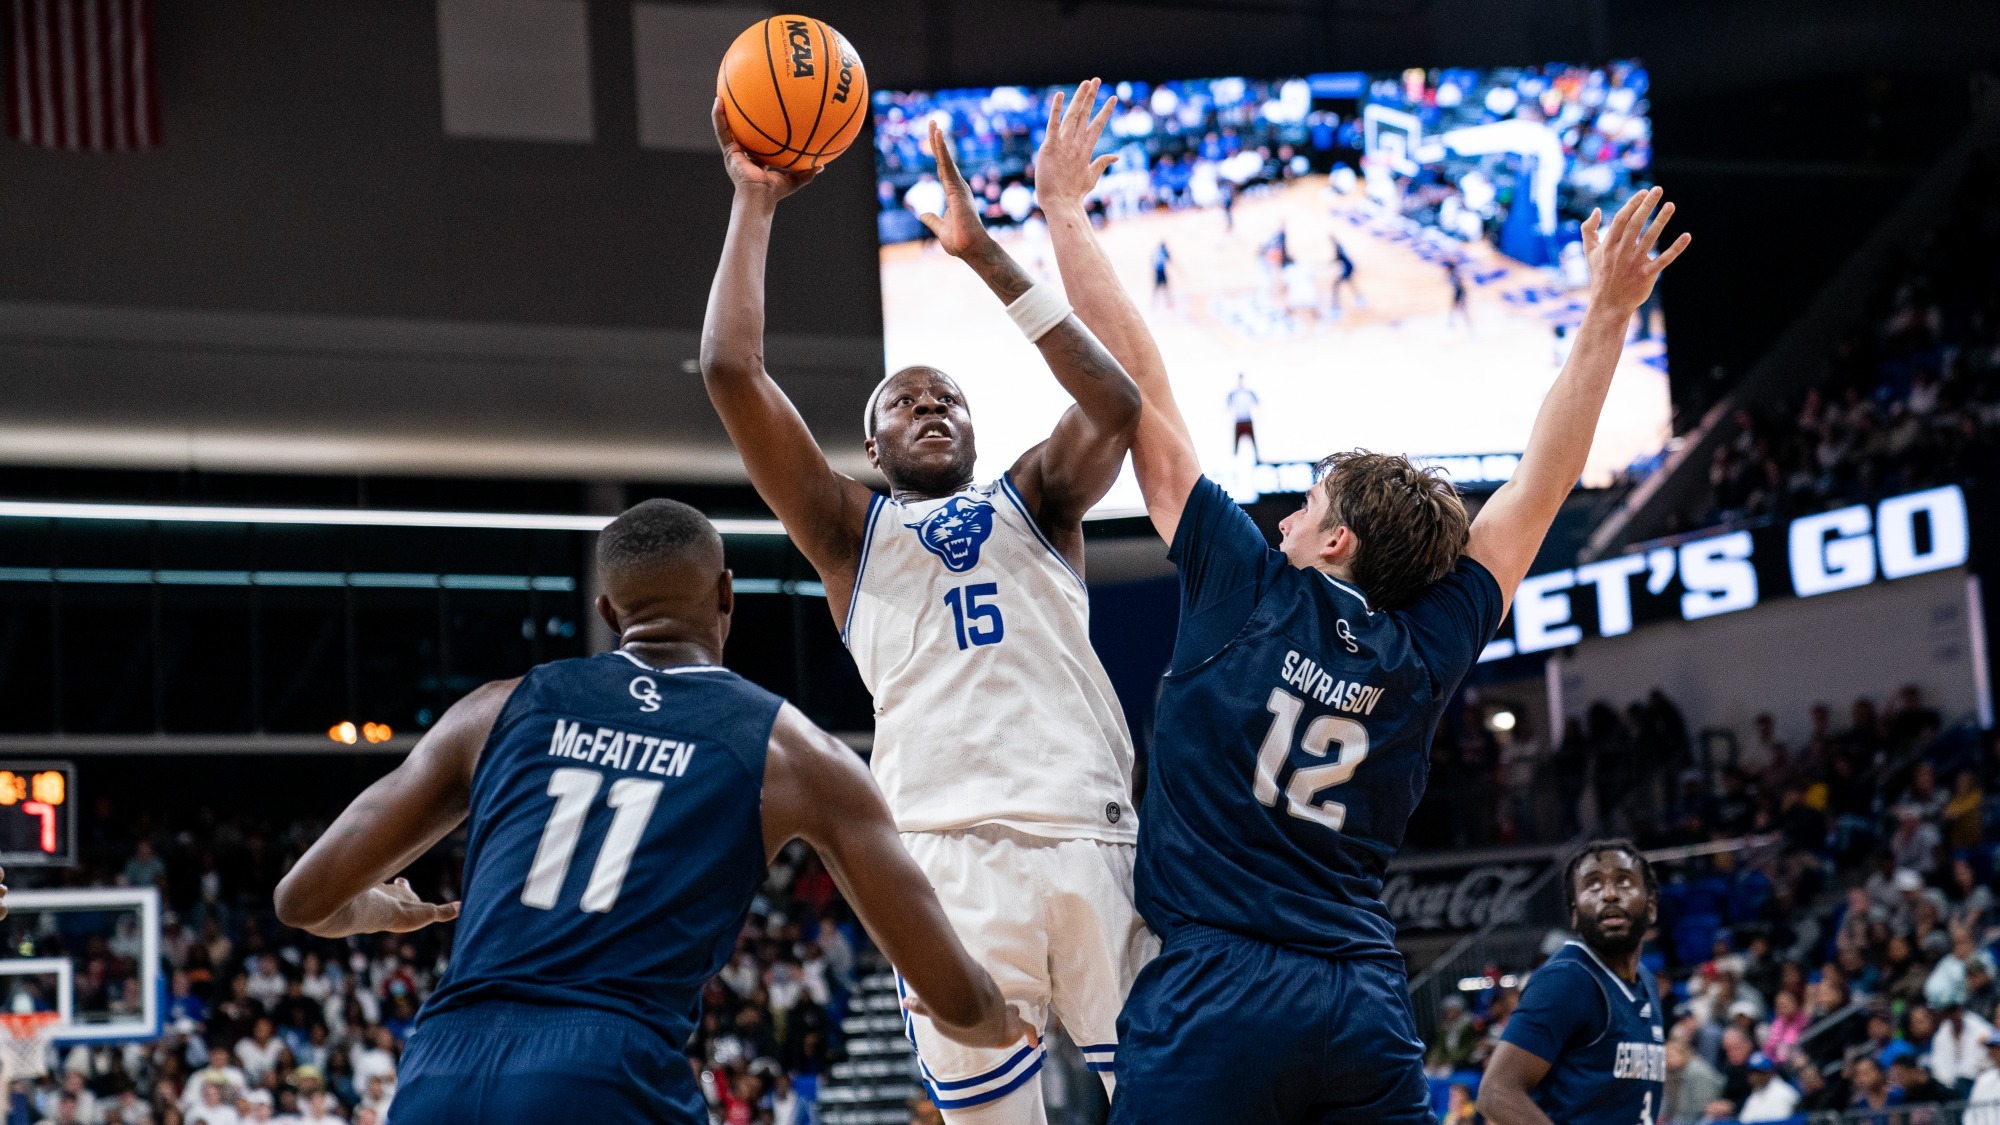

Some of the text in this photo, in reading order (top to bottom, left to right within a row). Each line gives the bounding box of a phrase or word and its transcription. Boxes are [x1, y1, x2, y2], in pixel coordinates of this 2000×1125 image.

[785, 20, 815, 78] NCAA
[1787, 483, 1971, 598] GO
[943, 581, 1004, 651] 15
[1281, 649, 1386, 716] SAVRASOV
[547, 718, 697, 778] McFATTEN
[1252, 686, 1370, 833] 12
[21, 801, 57, 853] 7
[519, 766, 666, 914] 11
